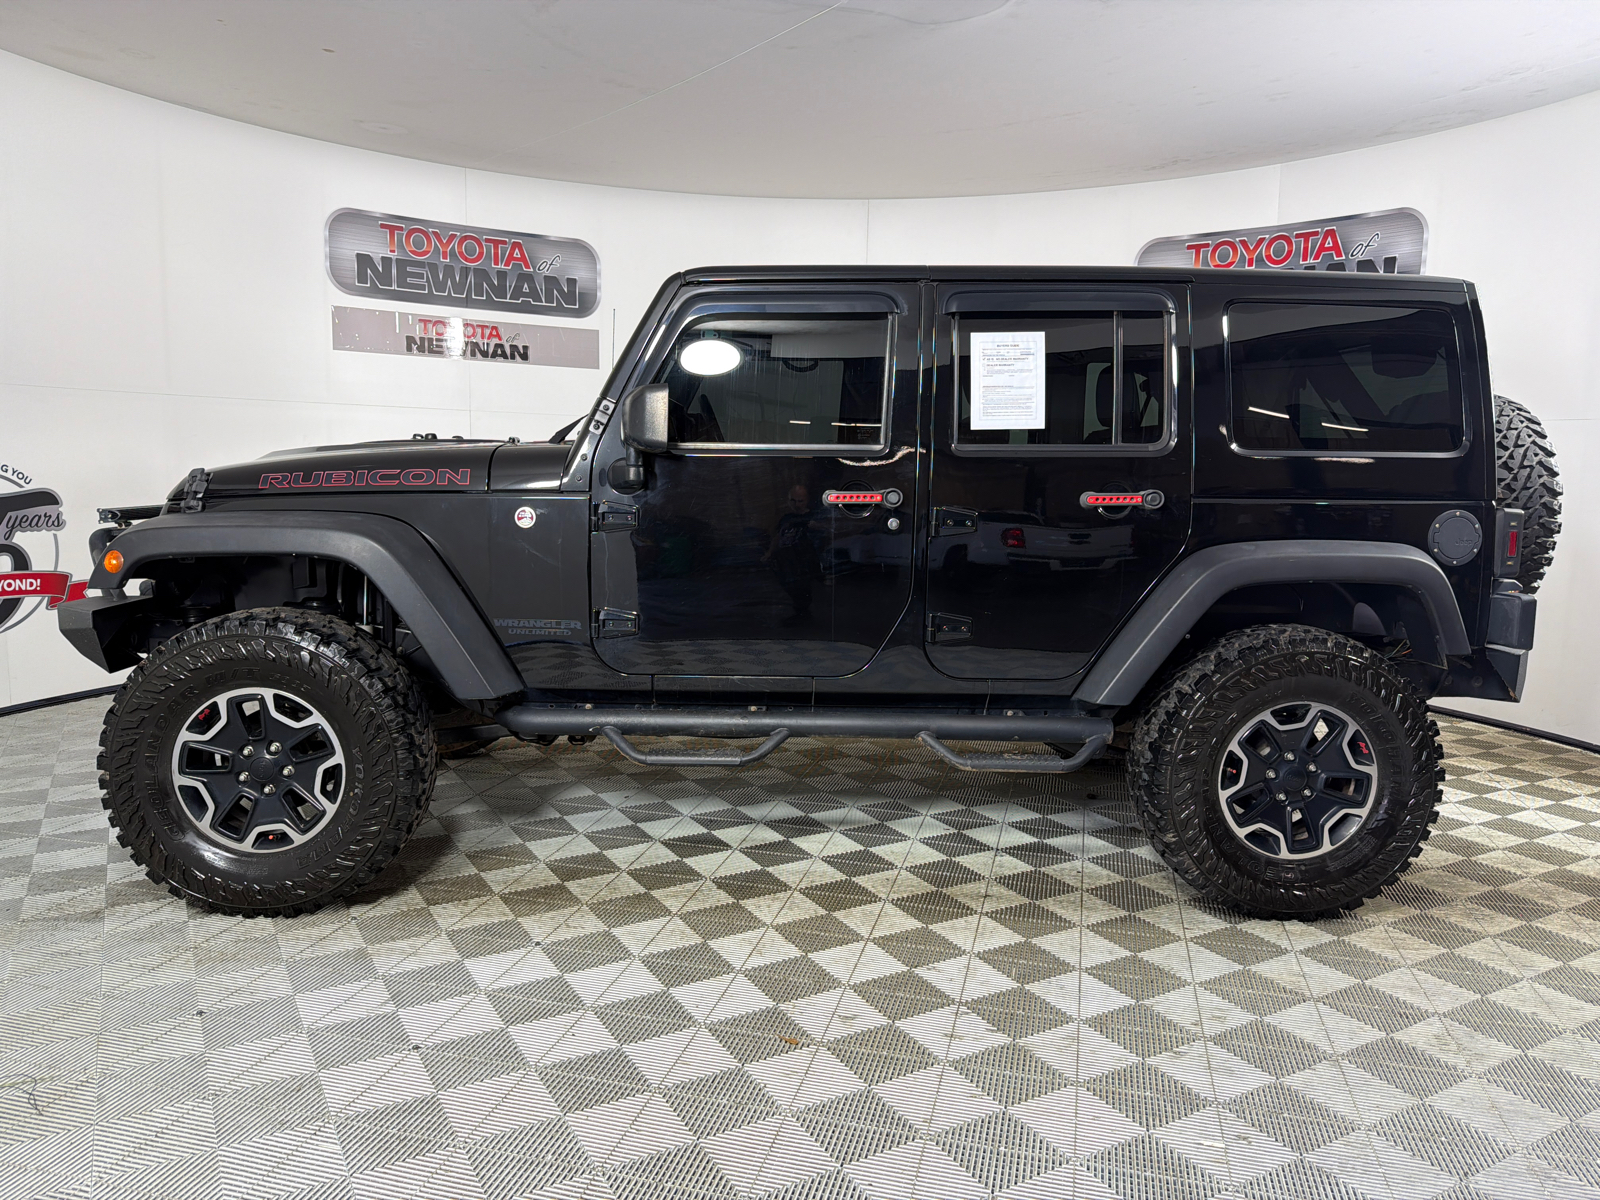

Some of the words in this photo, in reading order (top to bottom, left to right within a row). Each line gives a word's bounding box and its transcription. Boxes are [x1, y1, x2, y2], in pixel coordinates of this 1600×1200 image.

[378, 221, 533, 272] TOYOTA
[1186, 227, 1346, 268] TOYOTA
[1349, 232, 1380, 259] of
[536, 254, 561, 274] of
[355, 251, 579, 309] NEWNAN
[418, 318, 503, 342] TOOTA
[405, 335, 529, 361] NENAN
[11, 467, 33, 485] YOU
[258, 468, 471, 489] RUBICON
[4, 511, 64, 541] years
[493, 619, 582, 629] WRANGLER
[508, 628, 572, 636] UNLIMITED
